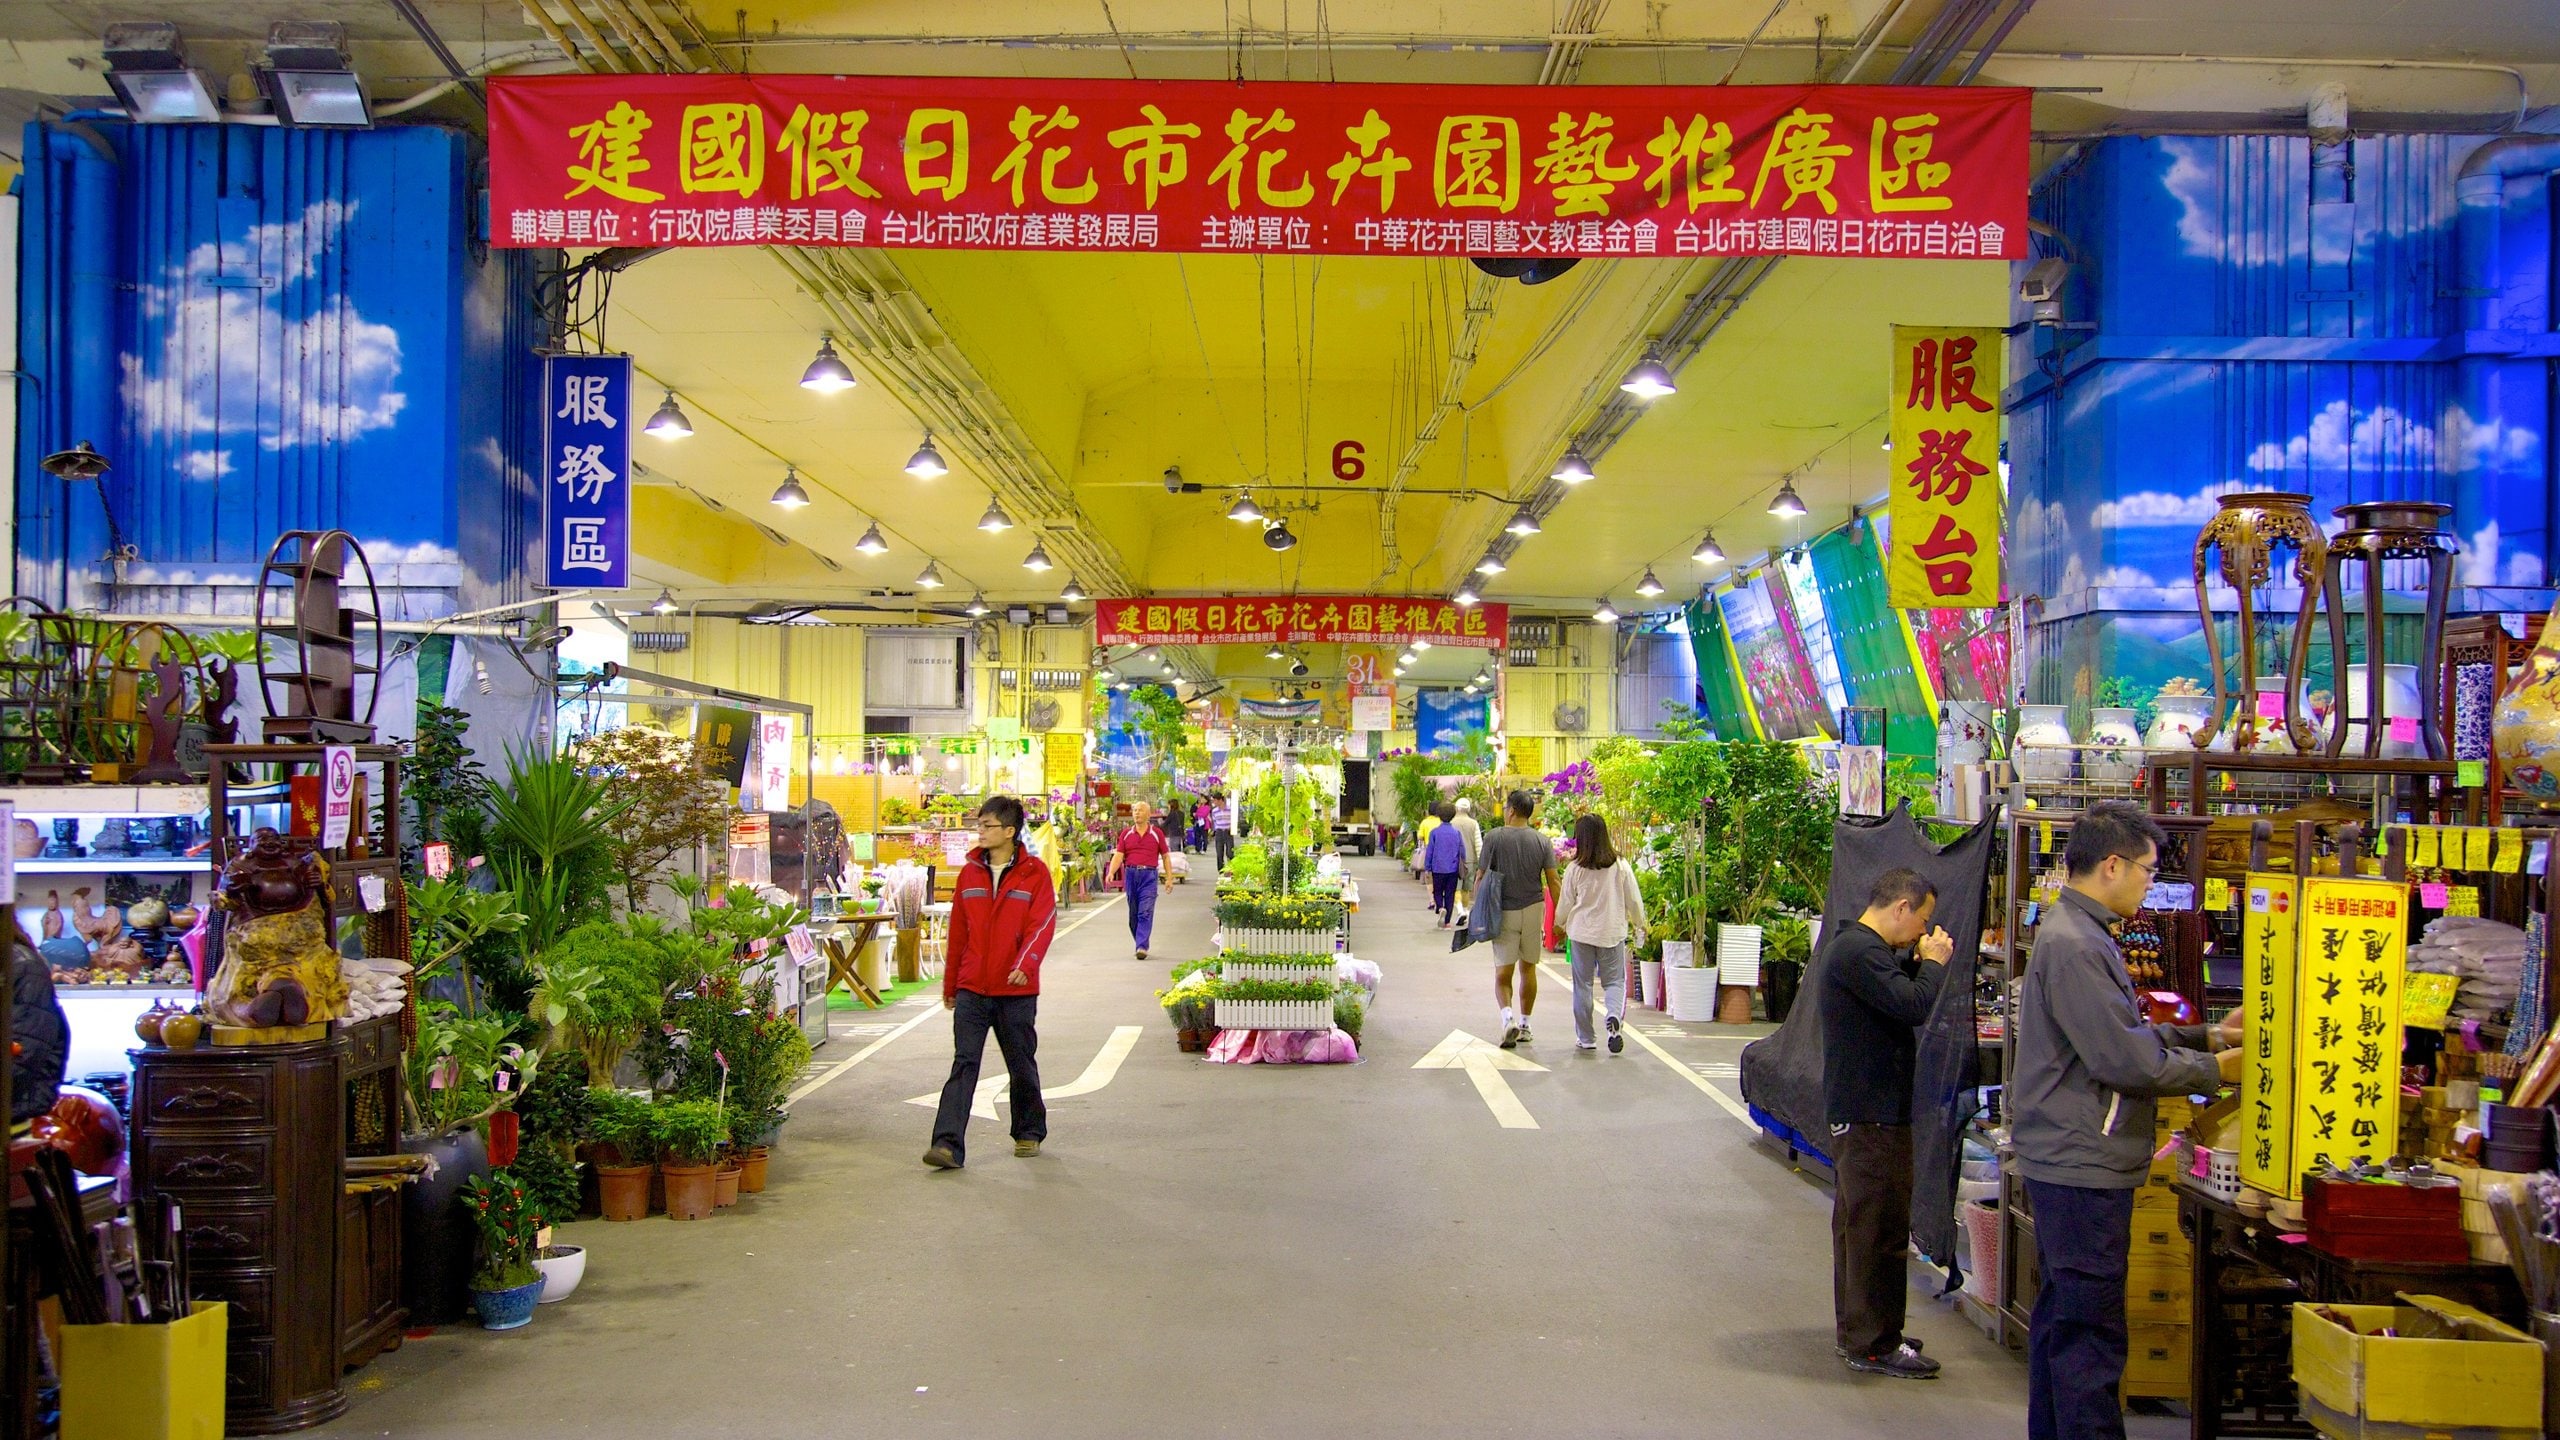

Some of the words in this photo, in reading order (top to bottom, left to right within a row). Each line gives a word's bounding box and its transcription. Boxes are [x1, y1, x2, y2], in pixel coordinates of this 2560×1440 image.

[564, 101, 1954, 217] 建國假日花市花卉園藝推廣區
[882, 210, 1158, 248] 台北市政府產業發展局
[1355, 217, 1659, 253] 中華花卉園藝文教基金會
[1673, 217, 2005, 256] 台北市建國假日花市自治會
[557, 375, 617, 573] 服務區
[1332, 440, 1365, 481] 6
[1906, 336, 1994, 597] 服務台
[1116, 604, 1487, 635] 建國假日花市花卉園藝推廣區
